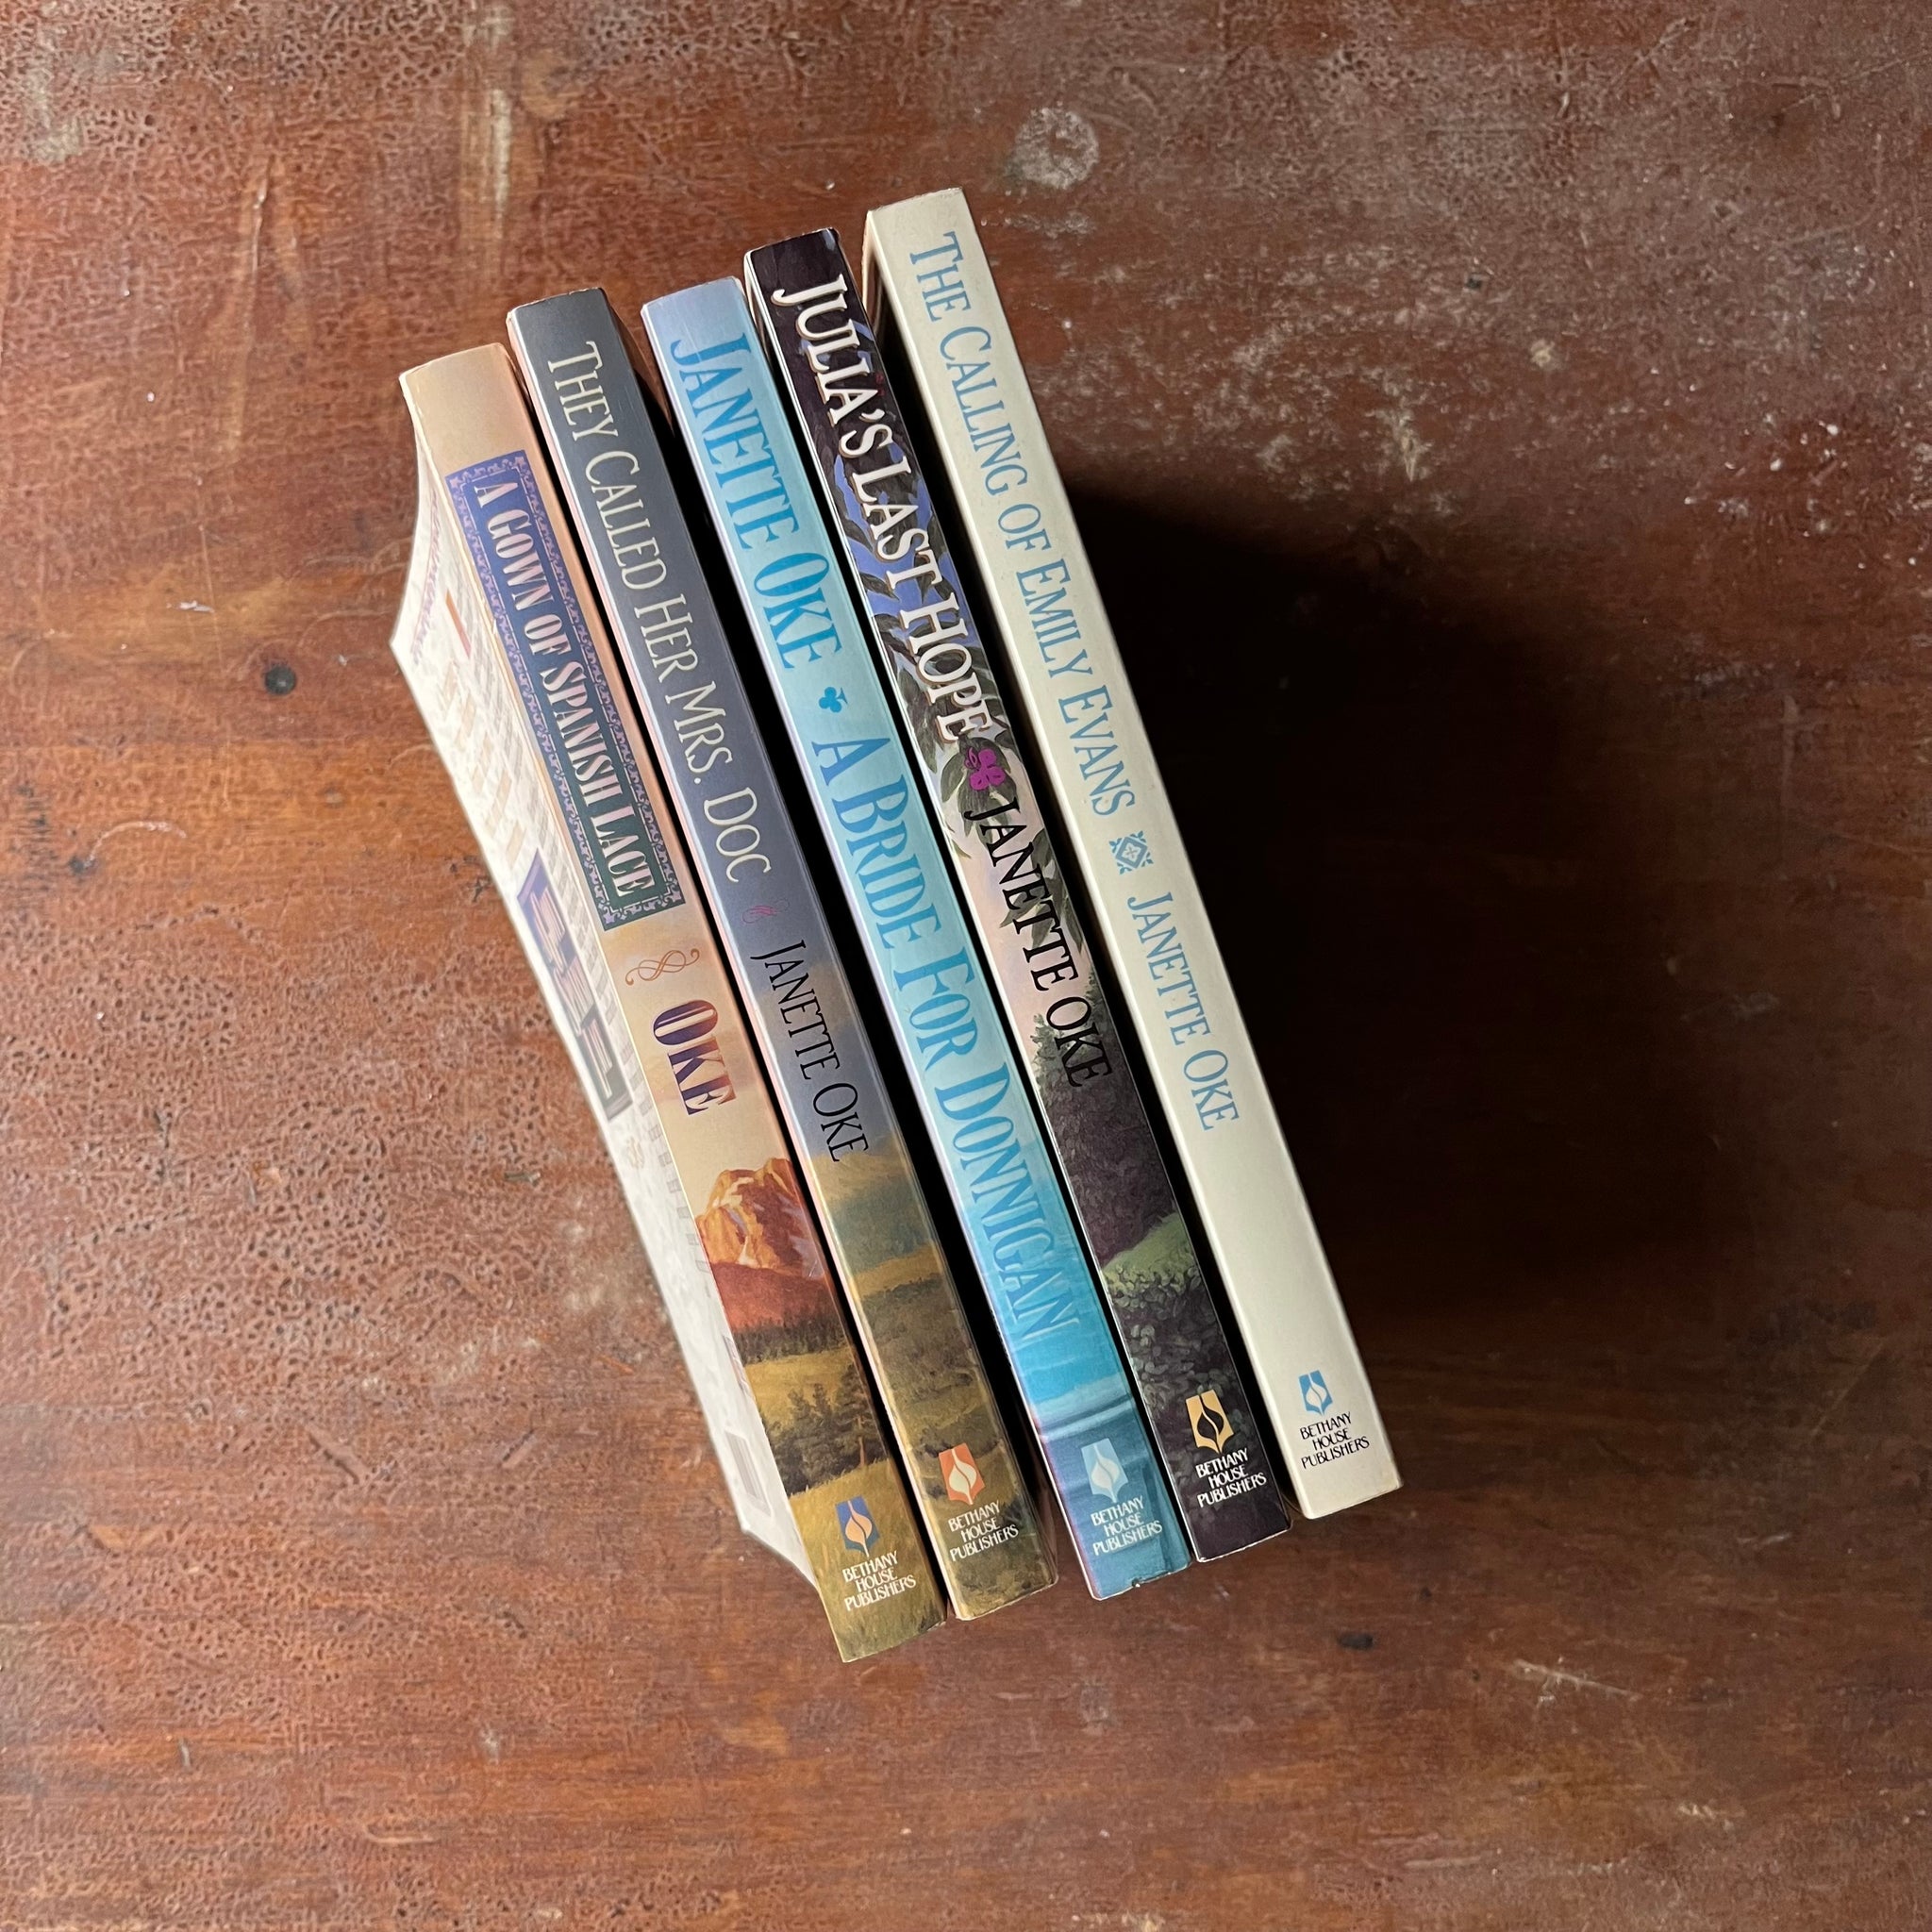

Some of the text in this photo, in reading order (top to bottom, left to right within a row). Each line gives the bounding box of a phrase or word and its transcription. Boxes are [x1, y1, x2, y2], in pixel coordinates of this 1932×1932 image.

[474, 481, 503, 508] A
[670, 332, 844, 670] JANETTE OKE
[771, 274, 993, 744] JULIA'S LAST HOPE
[909, 230, 1136, 817] THE CALLING OF EMILY EVANS
[487, 508, 554, 610] GOWN
[548, 341, 771, 884] THEY CALLED HER MRS. DOC
[525, 614, 572, 656] OF
[540, 660, 624, 807] SPANISH
[591, 807, 656, 897] LACE
[964, 796, 1114, 1088] JANETTE OKE
[1127, 891, 1241, 1132] JANETTE OKE
[652, 999, 737, 1115] OKE
[750, 940, 869, 1162] JANETTE OKE
[811, 737, 1080, 1341] A BRIDE FOR DONNIGAN
[1299, 1411, 1353, 1441] BETHANY
[1311, 1426, 1352, 1451] HOUSE
[1195, 1447, 1250, 1479] BETHANY
[1301, 1435, 1371, 1470] PUBLISHERS
[1196, 1472, 1267, 1508] PUBLISHERS
[1208, 1463, 1249, 1488] HOUSE
[948, 1500, 1001, 1532] BETHANY
[1090, 1495, 1144, 1527] BETHANY
[1103, 1512, 1144, 1537] HOUSE
[949, 1524, 1019, 1561] PUBLISHERS
[960, 1519, 1000, 1543] HOUSE
[1092, 1520, 1163, 1557] PUBLISHERS
[842, 1551, 898, 1583] BETHANY
[855, 1568, 897, 1592] HOUSE
[843, 1574, 916, 1611] PUBLISHERS
